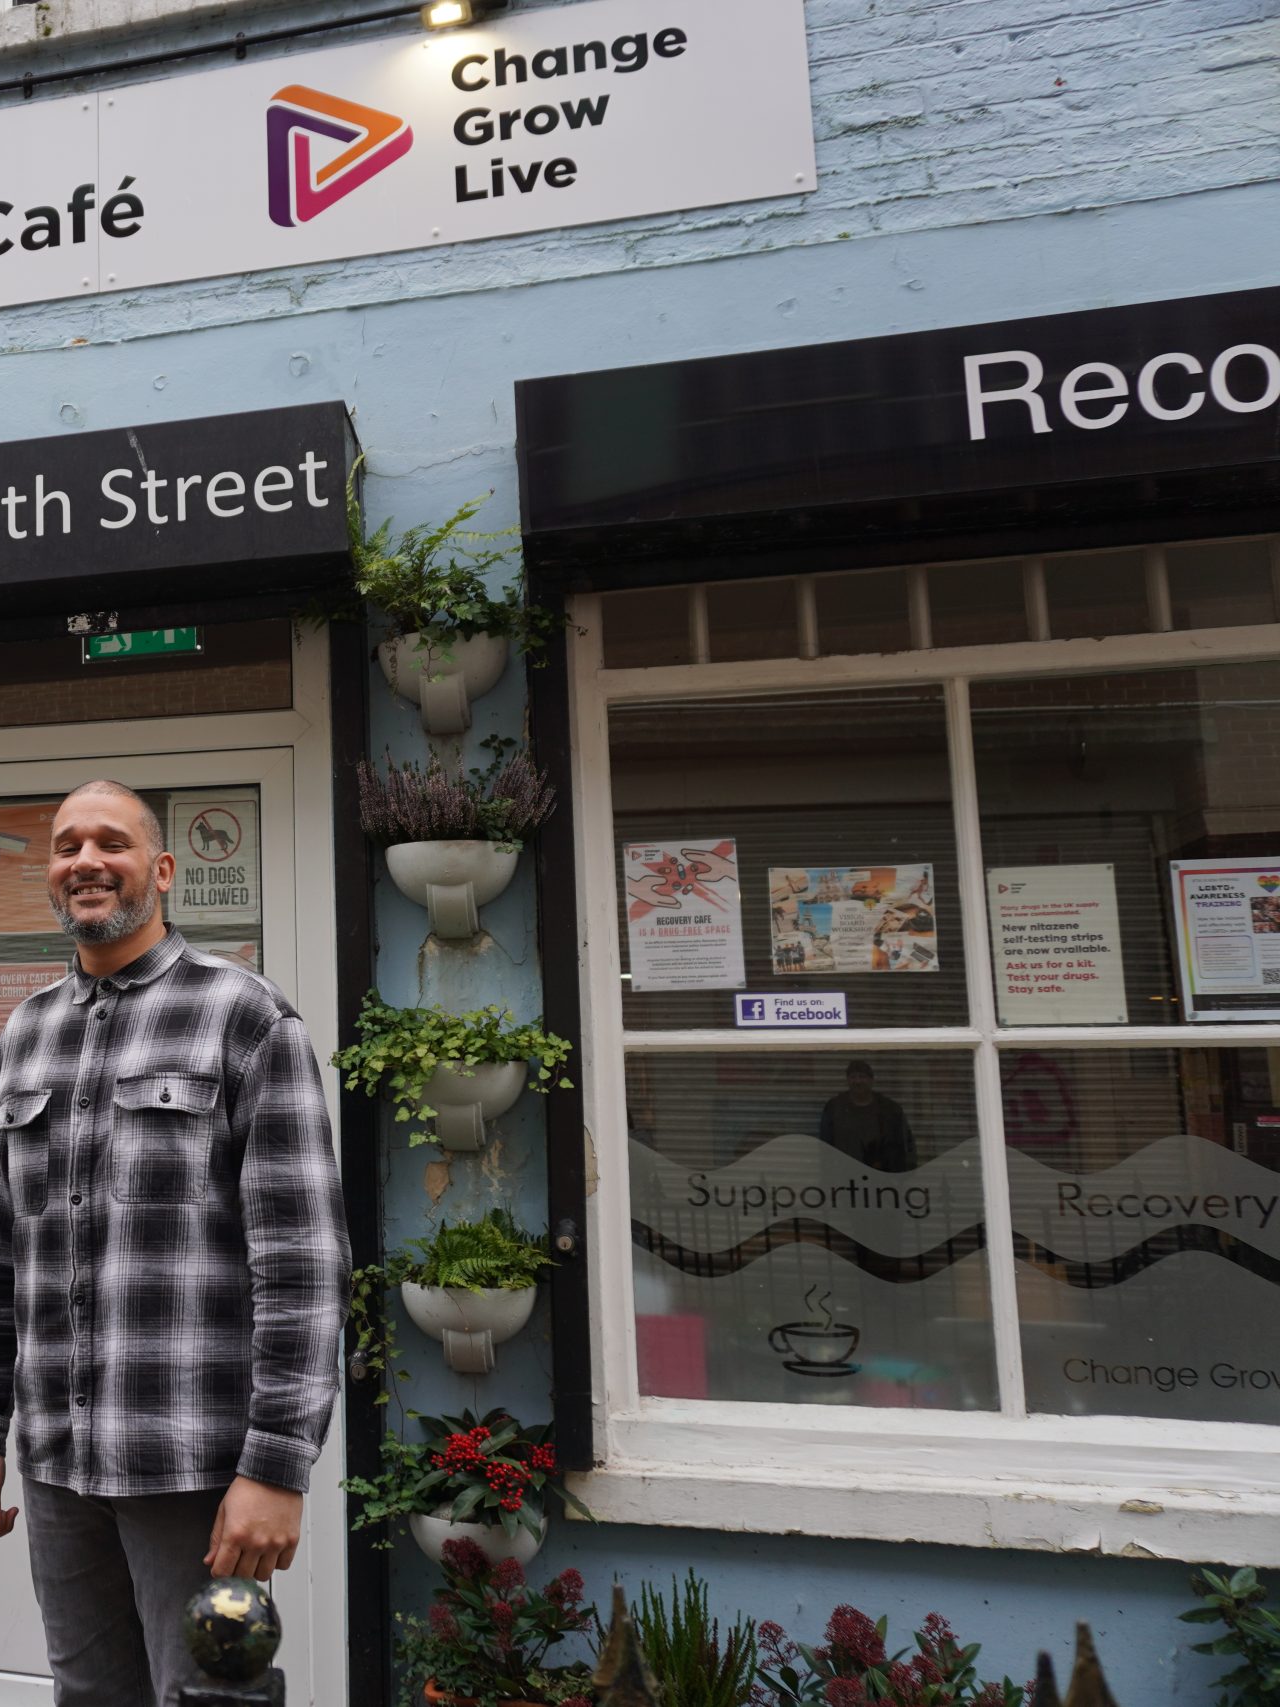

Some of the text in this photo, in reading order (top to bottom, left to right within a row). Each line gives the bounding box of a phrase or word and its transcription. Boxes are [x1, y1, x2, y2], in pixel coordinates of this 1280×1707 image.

[451, 27, 688, 92] Change
[453, 94, 610, 146] Grow
[454, 156, 579, 203] Live
[964, 343, 1280, 441] Reco
[100, 450, 330, 529] Street
[185, 866, 246, 885] NO DOGS
[183, 887, 249, 906] ALLOWED
[656, 914, 712, 926] RECOVERY CAFE
[639, 925, 731, 937] IS A DRUG-FREE SPACE
[1002, 922, 1079, 932] New nitazene
[1003, 933, 1104, 944] self-testing strips
[1004, 945, 1111, 956] are now available.
[1006, 962, 1027, 970] Ask
[1046, 961, 1063, 969] for
[1077, 960, 1096, 968] kit.
[29, 972, 50, 984] CAFE
[1007, 972, 1100, 982] Test your drugs.
[1008, 985, 1065, 994] Stay safe.
[774, 998, 794, 1006] Find
[775, 1007, 842, 1020] facebook
[687, 1172, 1280, 1230] Supporting Recovery
[1062, 1357, 1199, 1393] Change
